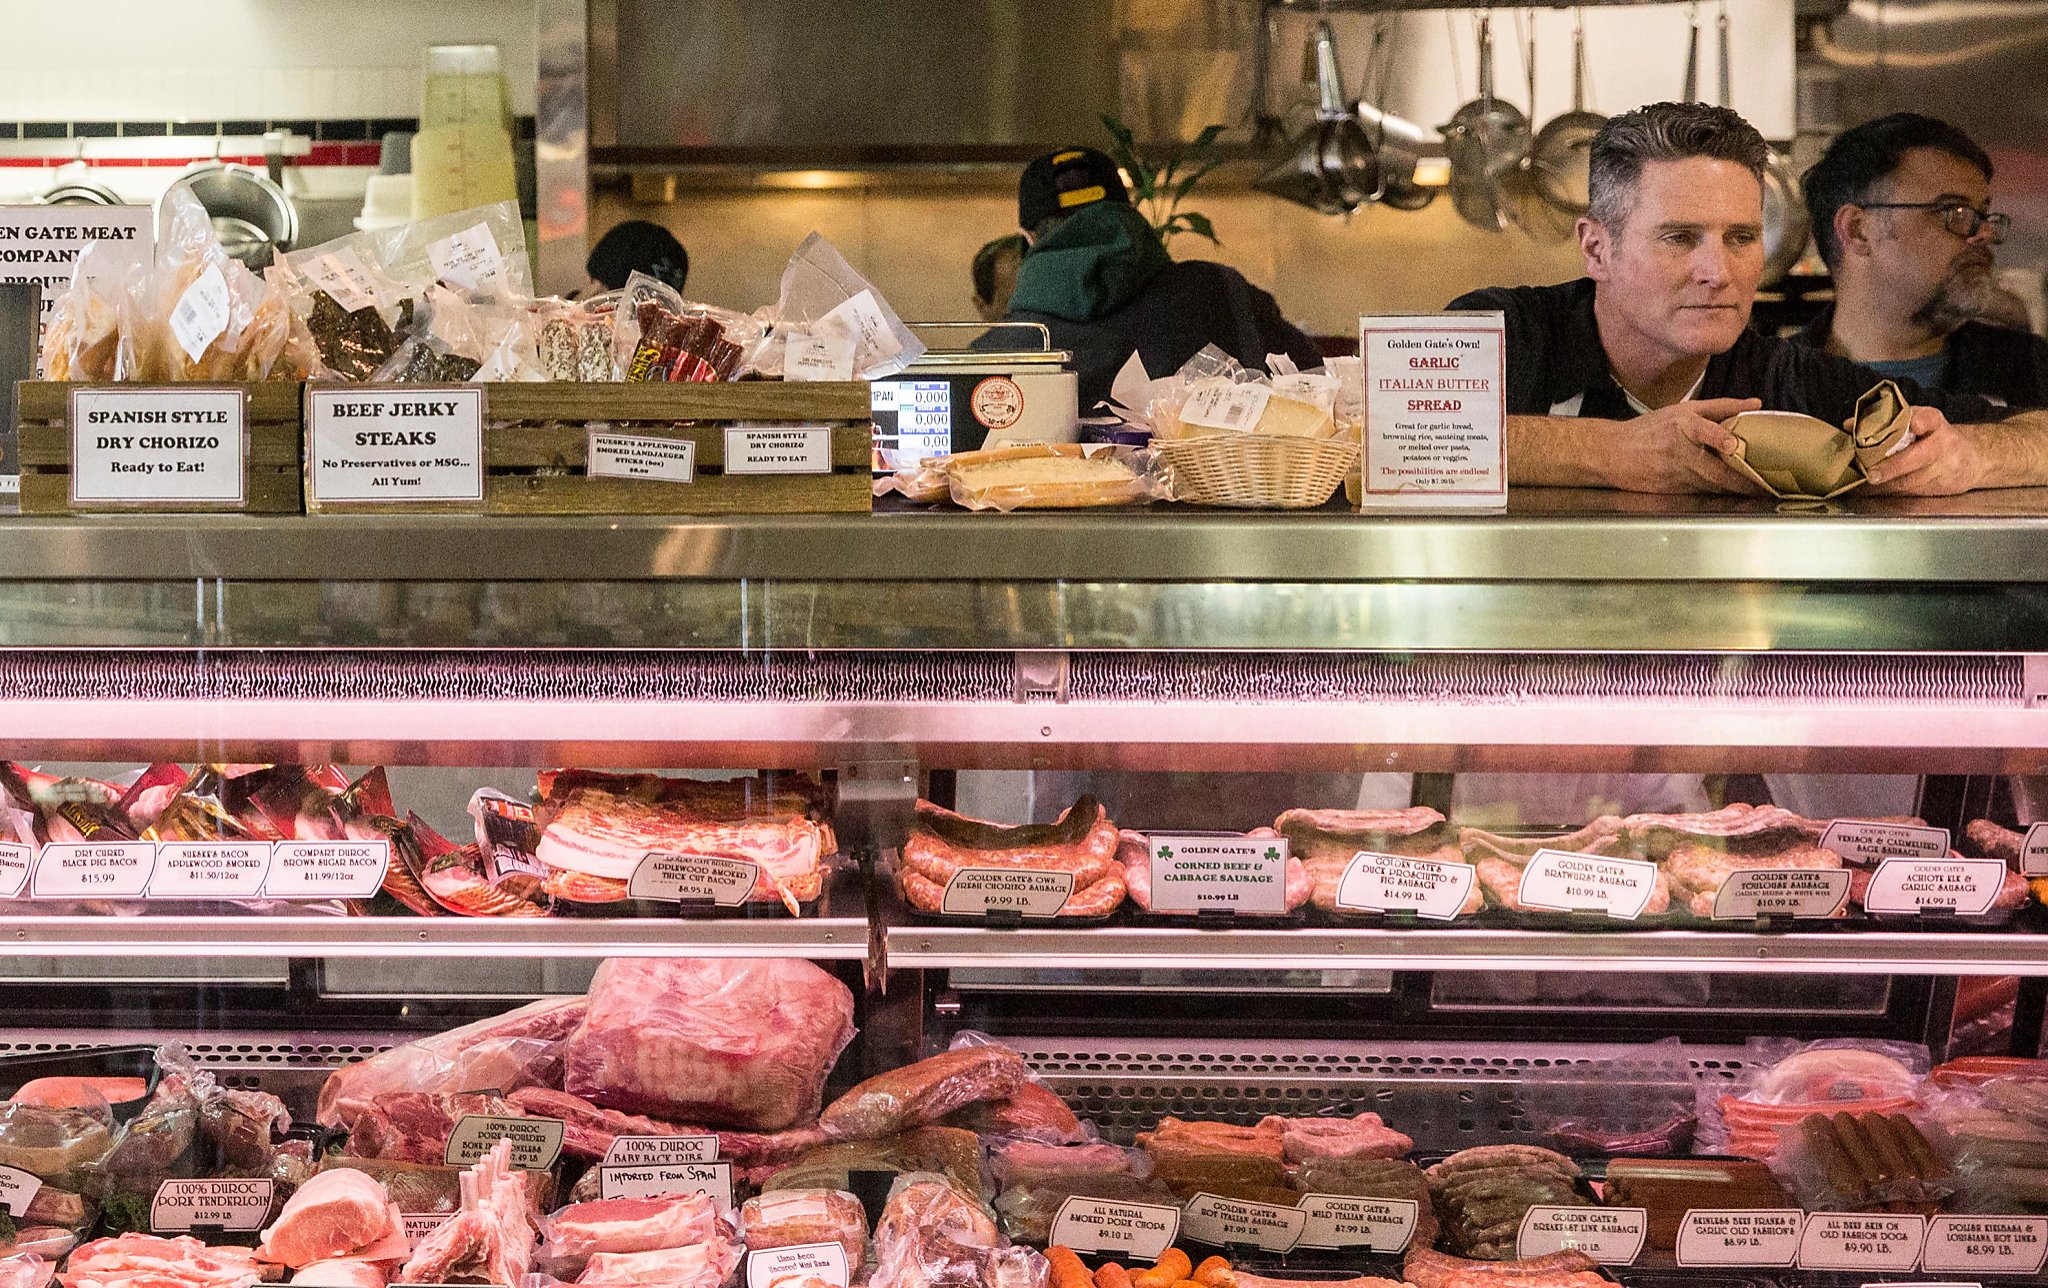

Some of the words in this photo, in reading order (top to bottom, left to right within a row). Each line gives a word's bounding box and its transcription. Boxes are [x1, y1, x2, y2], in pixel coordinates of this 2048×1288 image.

[25, 226, 78, 240] GATE
[82, 226, 137, 240] MEAT
[1387, 339, 1422, 350] Golden
[1424, 338, 1454, 349] Gate's
[1455, 339, 1480, 349] Own!
[1409, 357, 1460, 369] GARLIC
[1379, 378, 1433, 390] ITALIAN
[1437, 378, 1490, 390] BUTTER
[916, 391, 948, 403] 0.000
[332, 403, 385, 418] BEEF
[389, 402, 459, 417] JERKY
[1407, 400, 1462, 411] SPREAD
[88, 411, 167, 424] SPANISH
[171, 411, 228, 424] STYLE
[916, 413, 948, 425] 0.000
[1395, 422, 1415, 430] Great
[1416, 422, 1428, 430] for
[1429, 422, 1450, 431] garlic
[355, 431, 437, 446] STEAKS
[923, 436, 949, 447] 0.00
[1383, 432, 1417, 441] browning
[96, 436, 134, 449] DRY
[139, 436, 220, 449] CHORIZO
[596, 438, 635, 447] NUESKE'S
[637, 440, 687, 451] APPLEWOOD
[1408, 443, 1432, 451] melted
[596, 447, 630, 455] SMOKED
[631, 449, 685, 460] LANDJAEGER
[322, 459, 338, 469] No
[341, 458, 417, 469] Preservatives
[420, 460, 432, 468] or
[435, 458, 470, 468] MSG...
[615, 457, 643, 465] STICKS
[111, 461, 155, 475] Ready
[158, 462, 173, 473] to
[177, 461, 205, 473] Eat!
[1380, 466, 1396, 475] The
[372, 476, 389, 486] All
[392, 476, 422, 486] Yum!
[75, 849, 93, 857] DRY
[95, 849, 125, 857] CURED
[182, 850, 218, 858] NUESKE'S
[221, 850, 249, 858] BACON
[293, 848, 335, 858] COMPART
[338, 848, 370, 857] DUROC
[1181, 846, 1220, 855] GOLDEN
[1222, 846, 1256, 855] GATE'S
[62, 859, 88, 868] BLACK
[90, 859, 107, 867] PIG
[109, 858, 138, 867] BACON
[168, 859, 223, 868] APPLEWOOD
[225, 859, 261, 868] SMOKED
[283, 858, 316, 867] BROWN
[317, 858, 346, 867] SUGAR
[349, 858, 377, 867] BACON
[1174, 862, 1221, 870] CORNED
[1223, 862, 1252, 870] BEEF
[1253, 863, 1263, 871] &
[1375, 857, 1411, 868] GOLDEN
[1413, 863, 1442, 873] GATE'S
[1557, 860, 1594, 872] GOLDEN
[1596, 865, 1625, 876] GATE'S
[652, 863, 709, 875] APPLEWOOD
[711, 868, 748, 880] SMOKED
[1362, 865, 1386, 875] DUCK
[1388, 868, 1448, 883] PROSCIUTTO
[1751, 873, 1788, 881] GOLDEN
[1791, 873, 1820, 881] GATE'S
[81, 874, 115, 883] $15.99
[661, 871, 686, 881] THICK
[689, 874, 705, 882] CUT
[707, 876, 736, 886] BACON
[967, 873, 1002, 882] GOLDEN
[1005, 875, 1033, 883] GATE'S
[1035, 876, 1056, 884] OWN
[1163, 874, 1217, 882] CABBAGE
[1219, 874, 1274, 883] SAUSAGE
[1380, 876, 1395, 885] FIG
[1397, 878, 1436, 890] SAUSAGE
[1544, 868, 1597, 882] BRATWURST
[1598, 876, 1638, 888] SAUSAGE
[1906, 874, 1946, 882] ACHIOTE
[956, 882, 982, 890] FRESH
[984, 882, 1026, 891] CHORIZO
[1028, 884, 1067, 893] SAUSAGE
[1565, 886, 1594, 897] $10.99
[1741, 882, 1788, 890] TOULOUSE
[1901, 883, 1935, 892] GARLIC
[1937, 883, 1977, 893] SAUSAGE
[1197, 893, 1226, 901] $10.99
[1383, 889, 1412, 900] $14.99
[984, 895, 1012, 906] $9.99
[1016, 897, 1031, 906] LB.
[1914, 896, 1944, 906] $14.99
[485, 1122, 507, 1131] 100%
[509, 1124, 540, 1133] DUROC
[478, 1131, 502, 1140] PORK
[462, 1141, 483, 1150] BONE
[626, 1141, 657, 1152] 100%
[660, 1141, 704, 1152] DUROC
[614, 1153, 641, 1163] BABY
[643, 1154, 672, 1162] BACK
[609, 1172, 654, 1185] IMPORTED
[659, 1171, 685, 1181] FROM
[687, 1165, 717, 1181] SPAIN
[175, 1183, 208, 1194] 100%
[211, 1183, 257, 1194] DUROC
[158, 1196, 195, 1207] PORK
[197, 1195, 269, 1207] TENDERLOIN
[1093, 1206, 1107, 1215] ALL
[1108, 1207, 1143, 1219] NATURAL
[1213, 1202, 1247, 1214] GOLDEN
[1325, 1202, 1360, 1212] GOLDEN
[194, 1211, 220, 1220] $12.99
[222, 1212, 232, 1220] LB
[1201, 1208, 1218, 1218] HOT
[1220, 1212, 1249, 1223] ITALIAN
[1311, 1210, 1333, 1219] MILD
[1335, 1212, 1364, 1221] ITALIAN
[1366, 1215, 1404, 1225] SAUSAGE
[1552, 1213, 1587, 1222] GOLDEN
[1069, 1213, 1105, 1225] SMOKED
[1107, 1217, 1133, 1228] PORK
[1135, 1220, 1166, 1231] CHOPS
[1826, 1221, 1841, 1229] ALL
[1843, 1221, 1862, 1229] BEEF
[1098, 1229, 1121, 1239] $9.10
[1581, 1224, 1598, 1233] LINK
[1695, 1226, 1728, 1235] GARLIC
[1729, 1227, 1750, 1235] OLD
[1819, 1230, 1839, 1239] OLD
[1880, 1232, 1908, 1241] DOGS
[2014, 1234, 2038, 1242] LINKS
[1844, 1242, 1873, 1253] $9.90
[1966, 1245, 1995, 1255] $8.99
